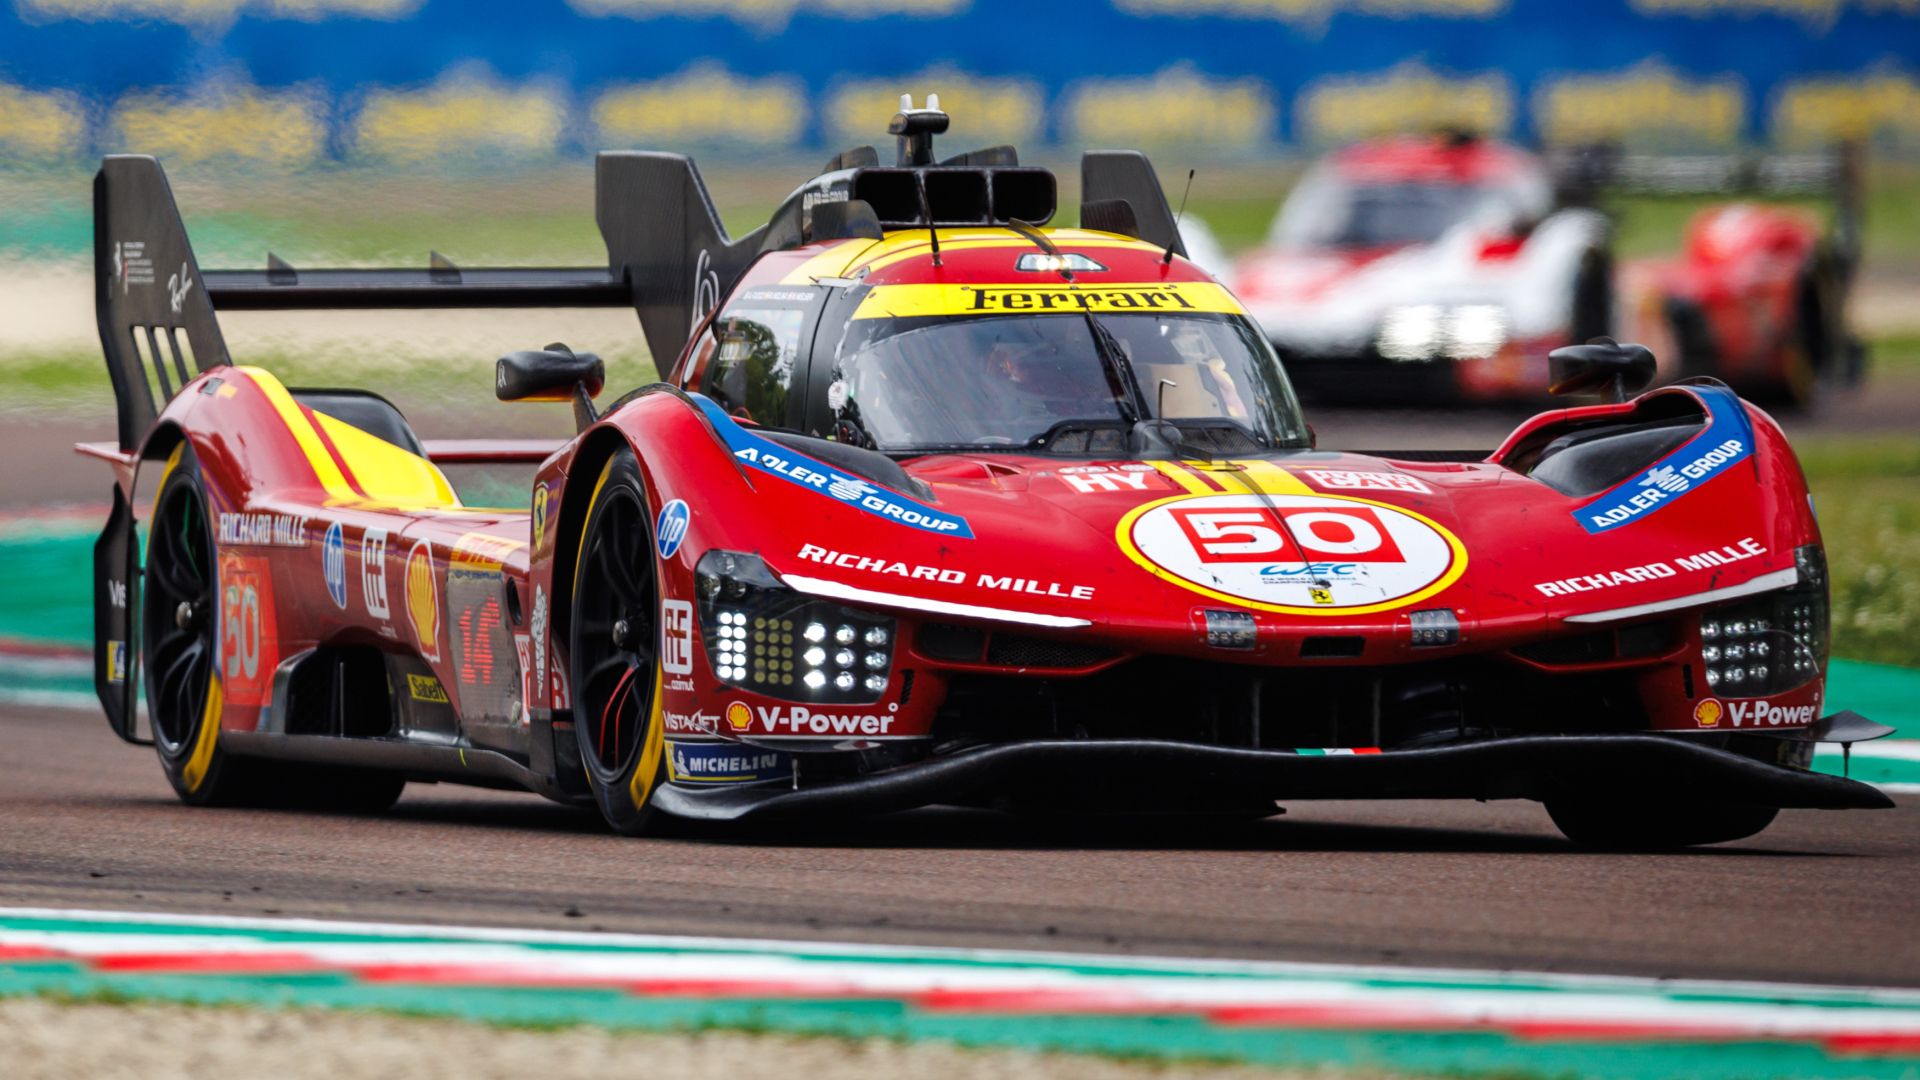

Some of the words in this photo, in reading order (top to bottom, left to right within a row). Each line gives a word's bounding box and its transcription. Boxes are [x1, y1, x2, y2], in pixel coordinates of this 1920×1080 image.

[966, 285, 1194, 310] Ferrari
[734, 446, 829, 489] ADLER
[862, 494, 960, 532] GROUP
[1061, 472, 1150, 493] HY
[1590, 487, 1668, 528] ADLER
[1680, 438, 1744, 480] GROUP
[219, 511, 272, 544] RICHARD
[274, 513, 307, 547] MILLE
[659, 502, 686, 557] hp
[1184, 511, 1383, 556] 50
[796, 542, 968, 585] RICHARD
[977, 574, 1097, 600] MILLE
[1259, 562, 1358, 576] WEC
[1533, 562, 1678, 598] RICHARD
[1674, 536, 1769, 572] MILLE
[226, 584, 260, 679] 50
[757, 705, 895, 734] V-Power
[1727, 700, 1816, 728] V-Power
[689, 753, 778, 773] MICHELIN
